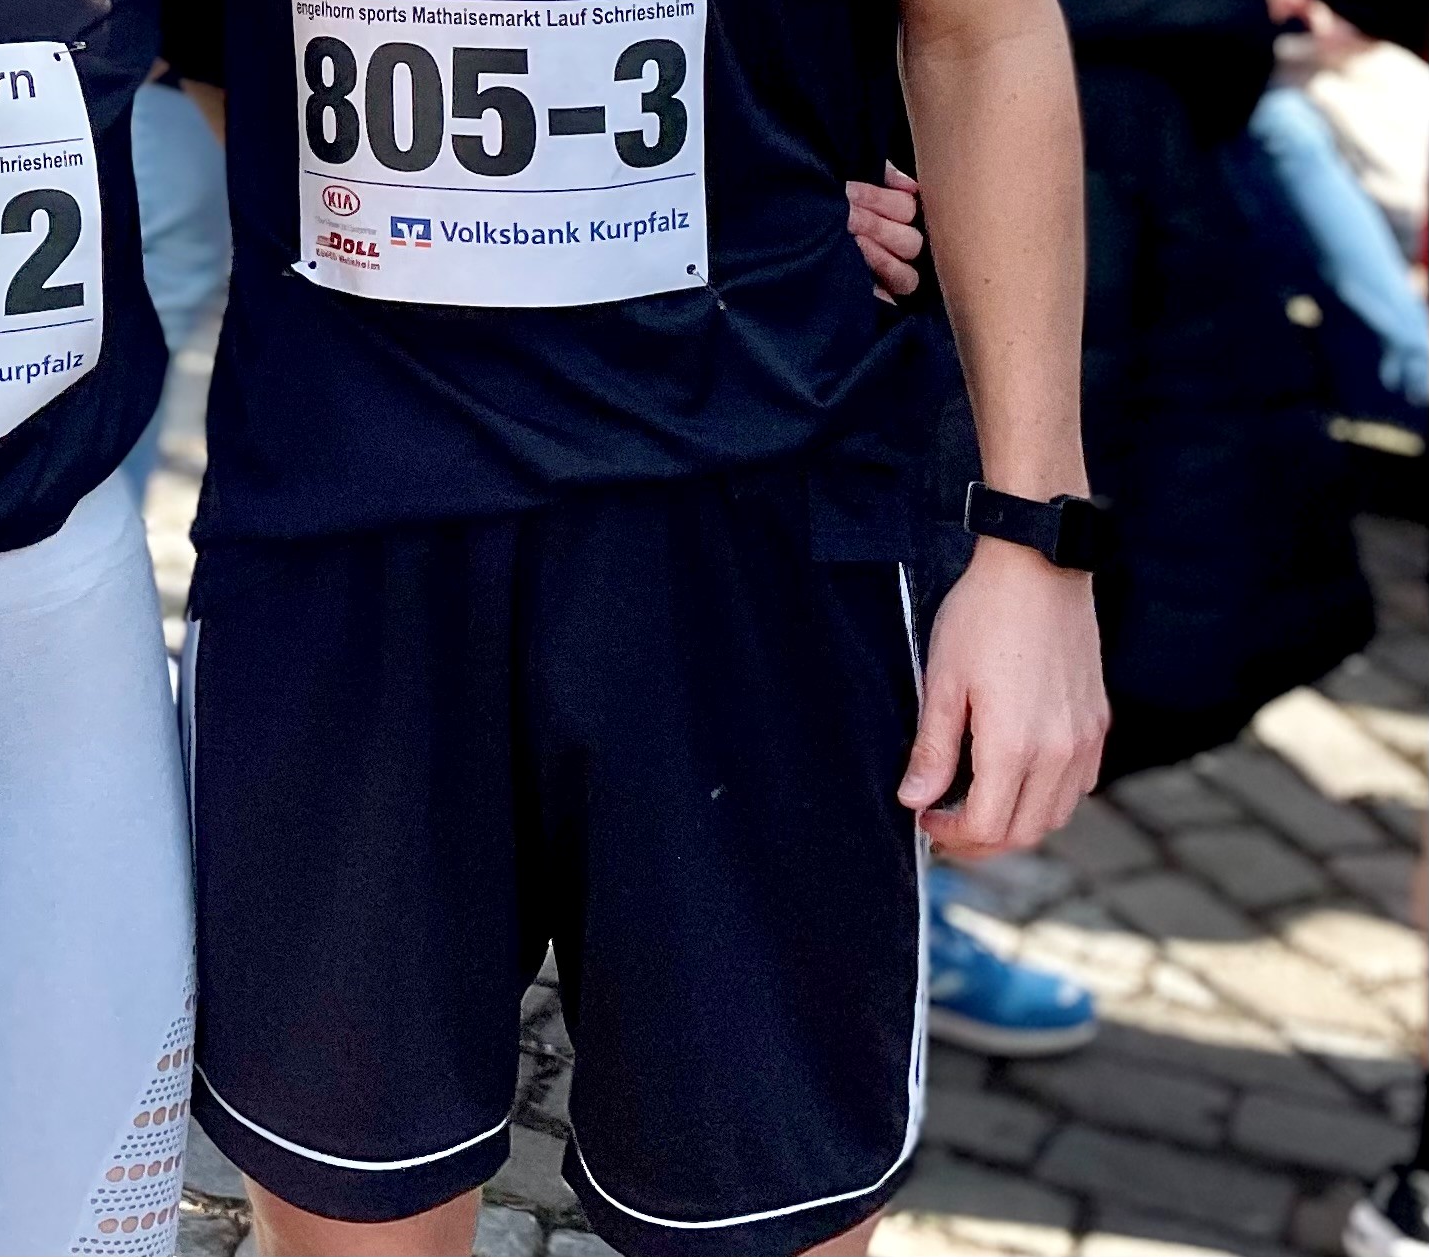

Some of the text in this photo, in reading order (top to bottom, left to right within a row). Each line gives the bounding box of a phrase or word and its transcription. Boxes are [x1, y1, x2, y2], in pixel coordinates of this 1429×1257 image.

[297, 0, 695, 27] engelhorn sports Mathaisemarkt Lauf Schriesheim
[304, 36, 689, 177] 805-3
[440, 208, 690, 245] Volksbank Kurpfalz
[329, 232, 381, 258] DOLL
